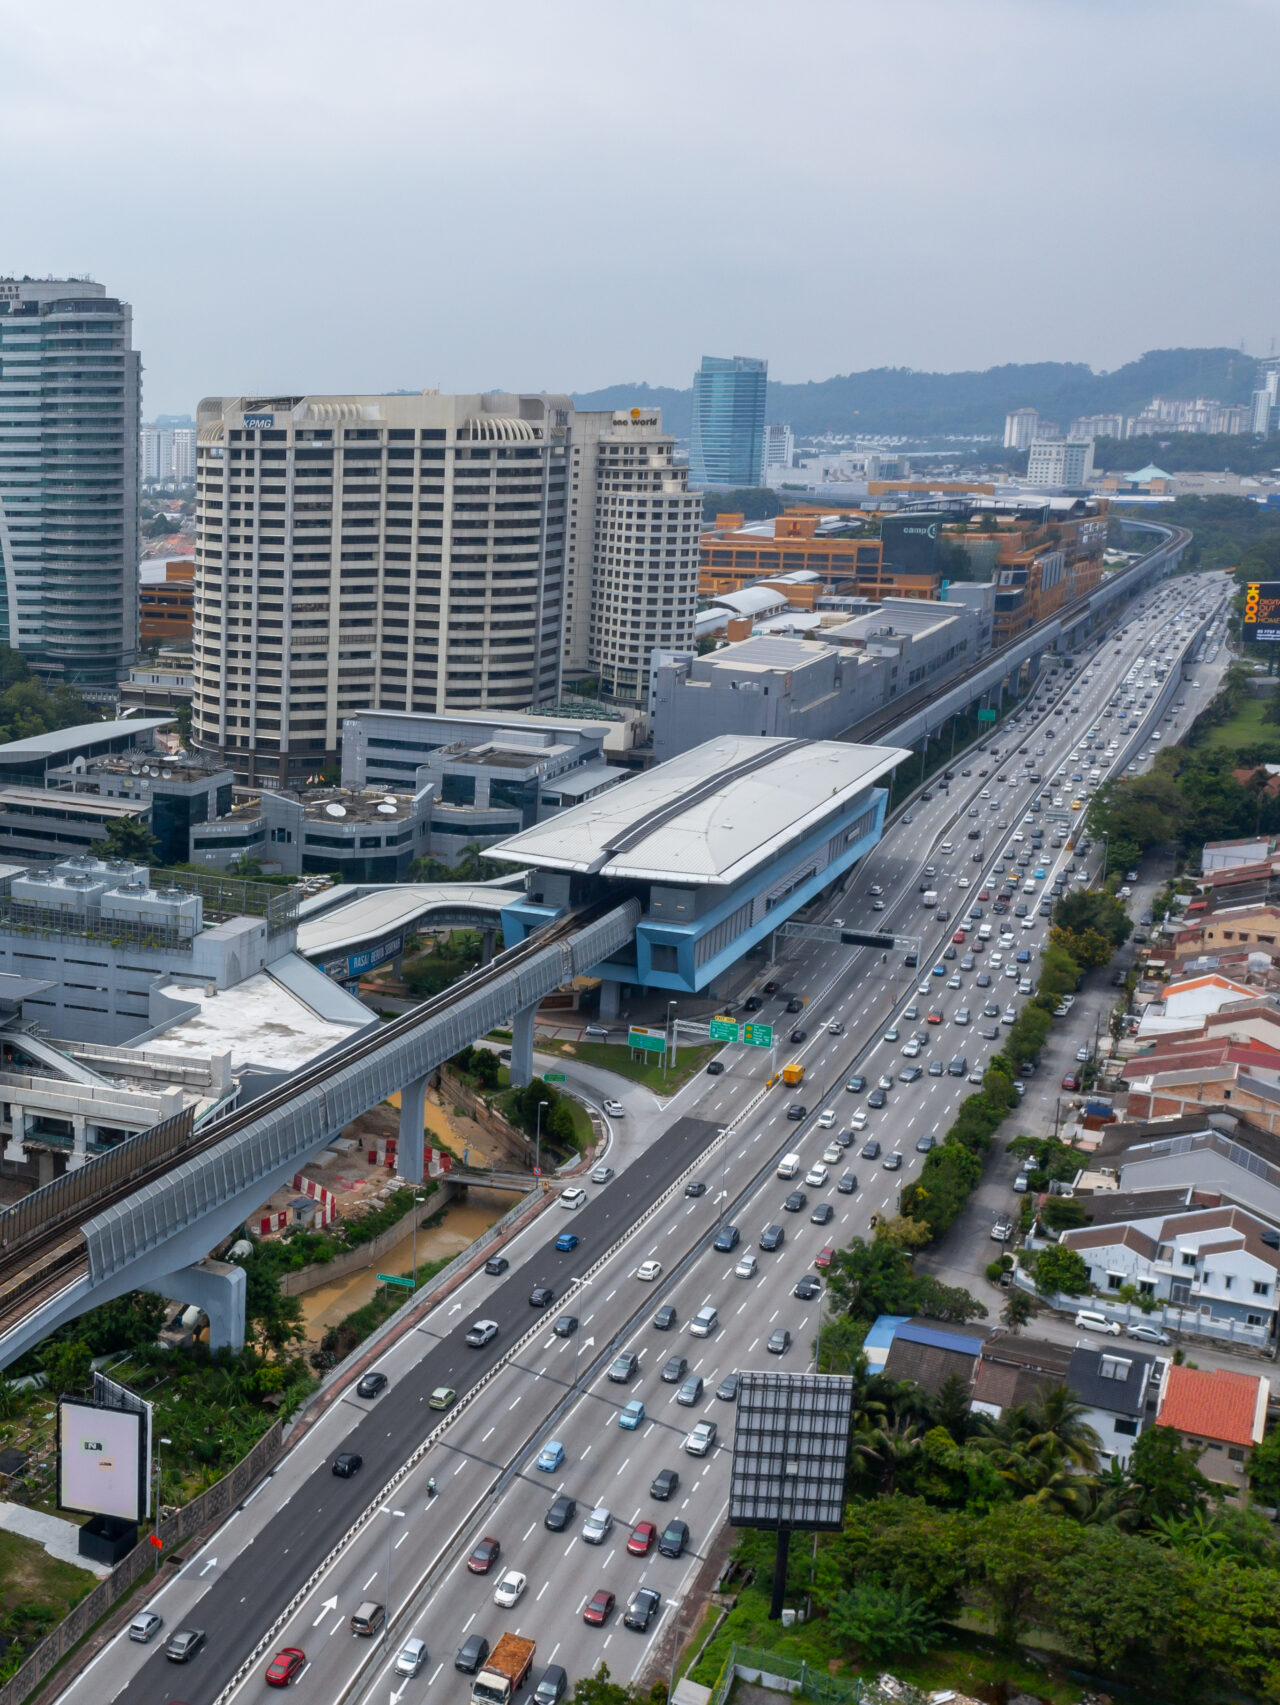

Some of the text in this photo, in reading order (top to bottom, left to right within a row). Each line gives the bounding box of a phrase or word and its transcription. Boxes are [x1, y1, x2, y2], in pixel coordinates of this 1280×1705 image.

[242, 419, 272, 429] KPMG
[631, 417, 658, 426] world
[903, 527, 927, 535] camp
[1244, 583, 1260, 624] DOOH
